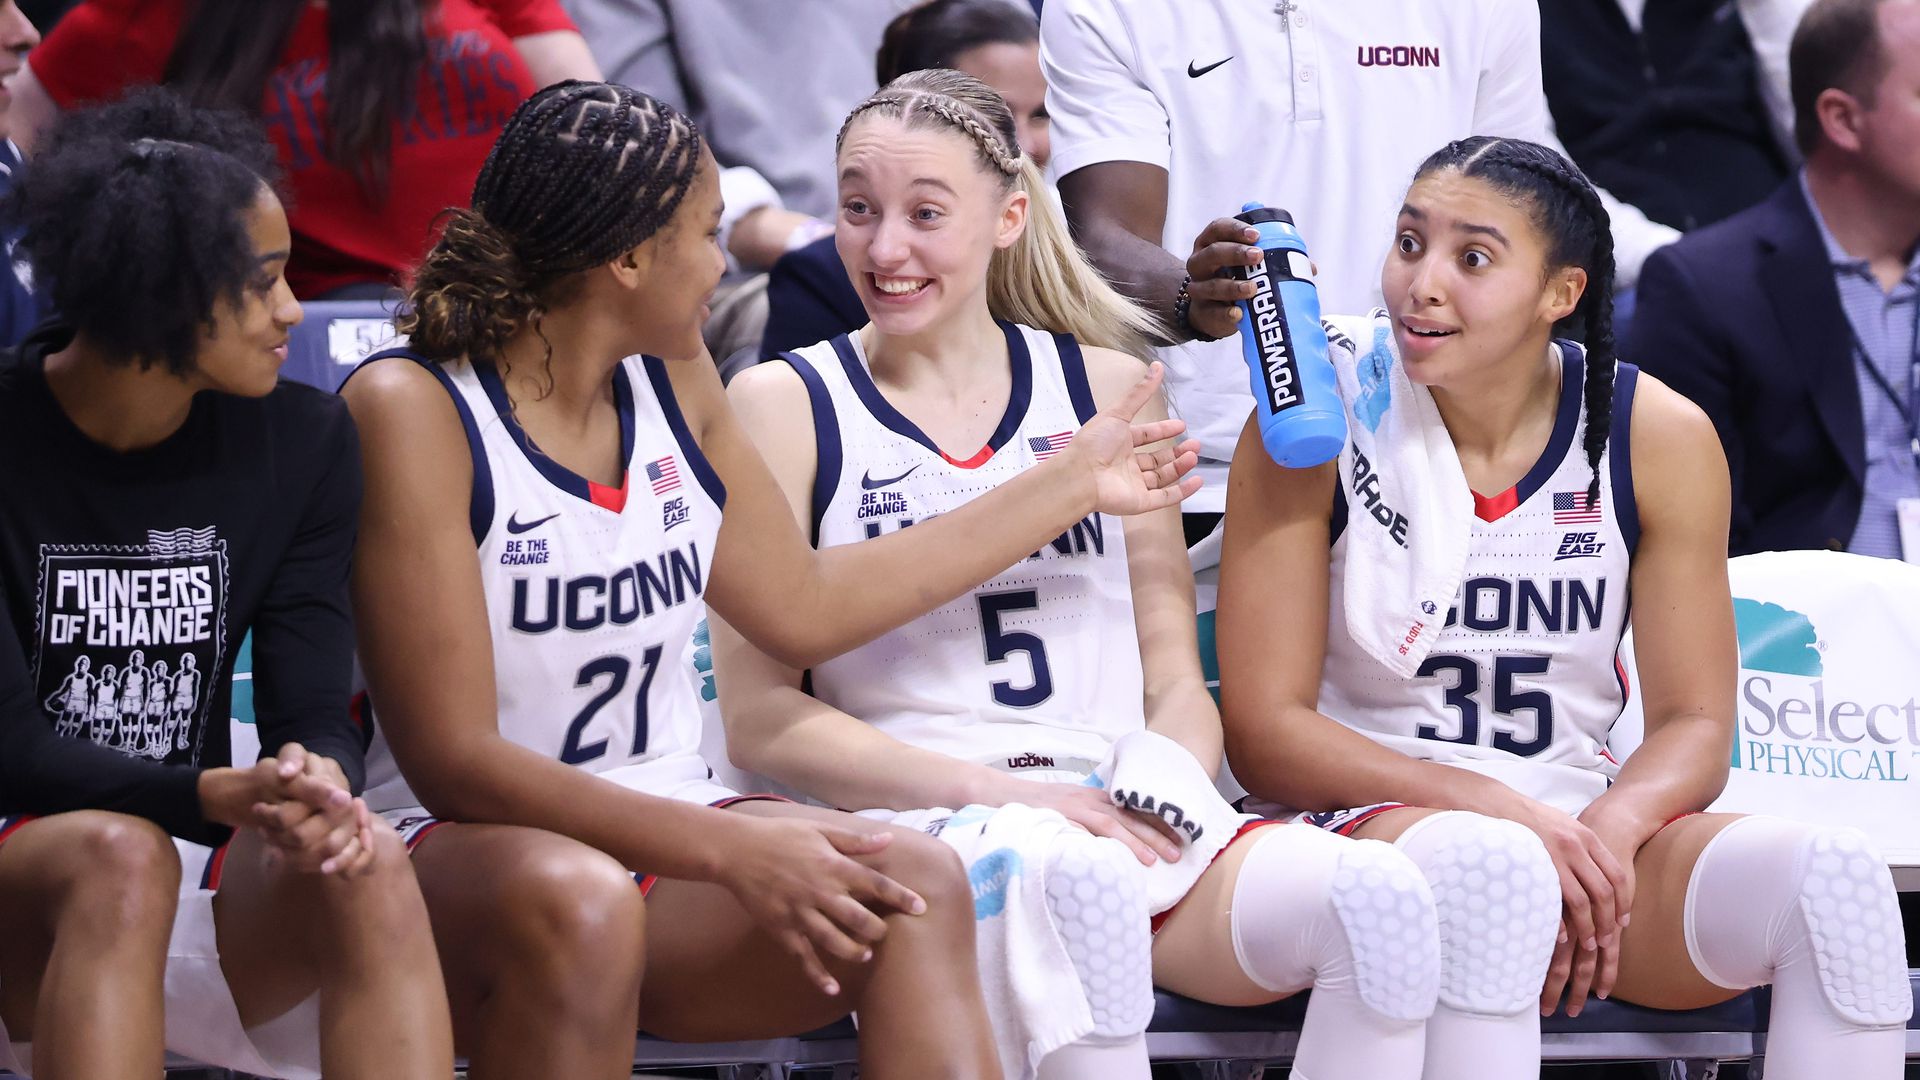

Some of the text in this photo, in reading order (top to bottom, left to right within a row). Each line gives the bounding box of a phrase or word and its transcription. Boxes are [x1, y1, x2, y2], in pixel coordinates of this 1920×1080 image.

[1357, 45, 1440, 67] UCONN
[1244, 258, 1298, 408] POWERADE
[664, 497, 684, 515] BIG
[857, 500, 908, 519] CHANGE
[861, 491, 904, 505] BE THE
[664, 506, 690, 525] EAST
[506, 538, 548, 553] BE THE
[1556, 543, 1606, 556] EAST
[1562, 532, 1599, 544] BIG
[500, 551, 550, 566] CHANGE
[56, 565, 213, 610] PIONEERS
[509, 540, 703, 635] UCONN
[50, 604, 213, 647] OF CHANGE
[1398, 620, 1425, 656] FUDD 35
[975, 586, 1055, 710] 5
[559, 641, 665, 766] 21
[1414, 652, 1554, 759] 35
[1743, 675, 1920, 747] Select
[1007, 754, 1055, 769] UCONN
[1747, 740, 1909, 783] PHYSICAL
